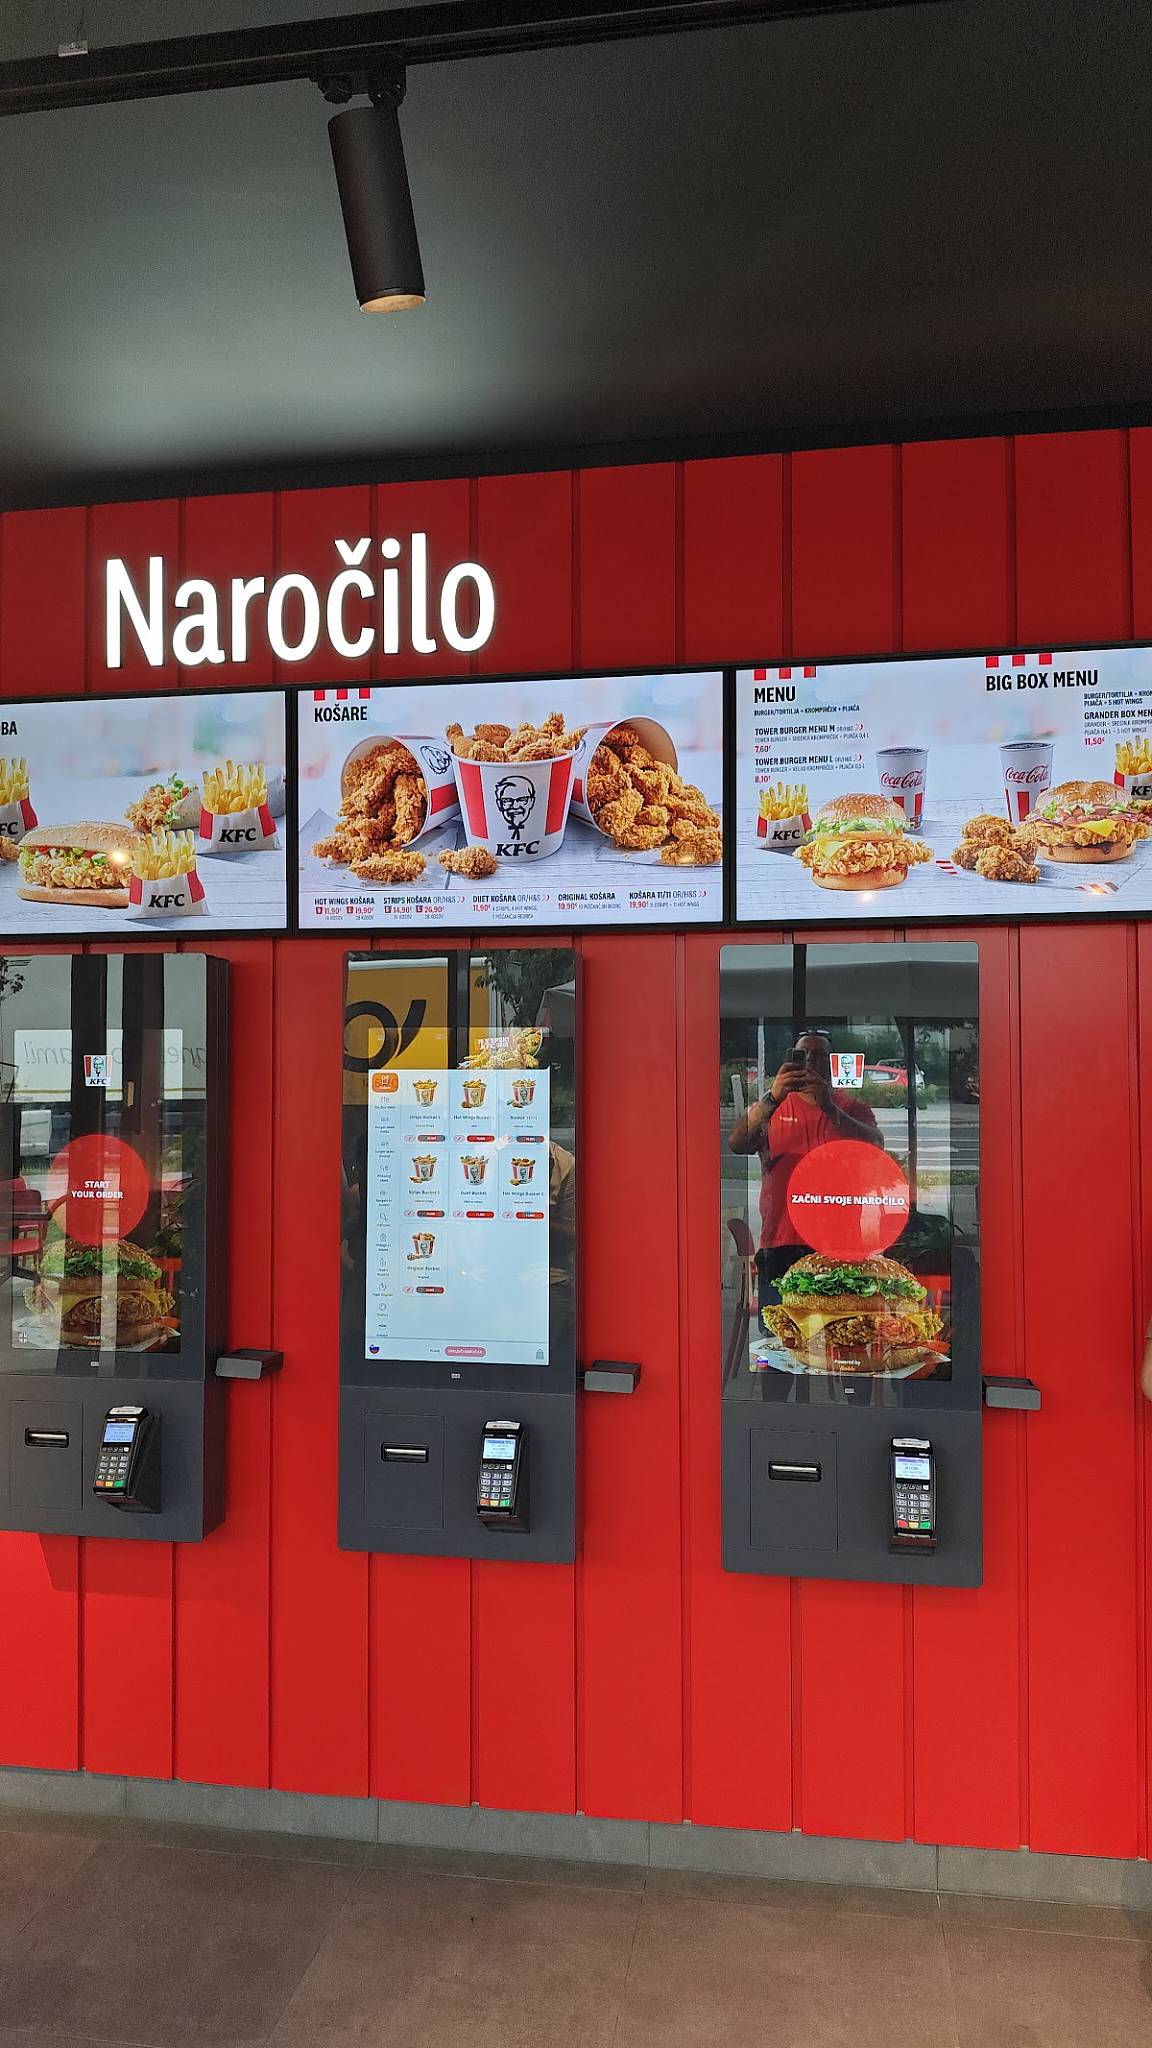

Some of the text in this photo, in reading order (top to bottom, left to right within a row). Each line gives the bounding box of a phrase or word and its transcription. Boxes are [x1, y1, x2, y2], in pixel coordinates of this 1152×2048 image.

[106, 532, 495, 669] Naročilo
[986, 670, 1098, 691] BIG BOX MENU
[754, 686, 796, 703] MENU
[314, 705, 368, 723] KOŠARE
[1084, 711, 1119, 720] GRANDER
[1121, 710, 1136, 718] BOX
[755, 727, 779, 736] TOWER
[780, 726, 807, 735] BURGER
[809, 725, 828, 733] MENU
[755, 757, 779, 766] TOWER
[780, 756, 807, 765] BURGER
[809, 755, 828, 764] MENU
[881, 769, 923, 789] Coca-Cola
[1005, 764, 1049, 784] Coca-Cola
[1131, 785, 1152, 796] KF
[219, 828, 256, 843] KFC
[772, 829, 800, 841] KFC
[495, 839, 540, 857] KFC
[349, 896, 375, 904] KOŠARA
[383, 896, 405, 904] STRIPS
[406, 895, 431, 904] KOŠARA
[473, 895, 489, 903] DUET
[490, 893, 516, 903] KOŠARA
[558, 891, 616, 901] ORIGINAL KOŠARA
[629, 890, 655, 899] KOŠARA
[149, 894, 185, 908] KFC
[837, 1078, 858, 1086] KFC
[84, 1180, 110, 1189] START
[71, 1190, 123, 1199] YOUR ORDER
[791, 1193, 905, 1206] ZAČNI SVOJE NAROČILO
